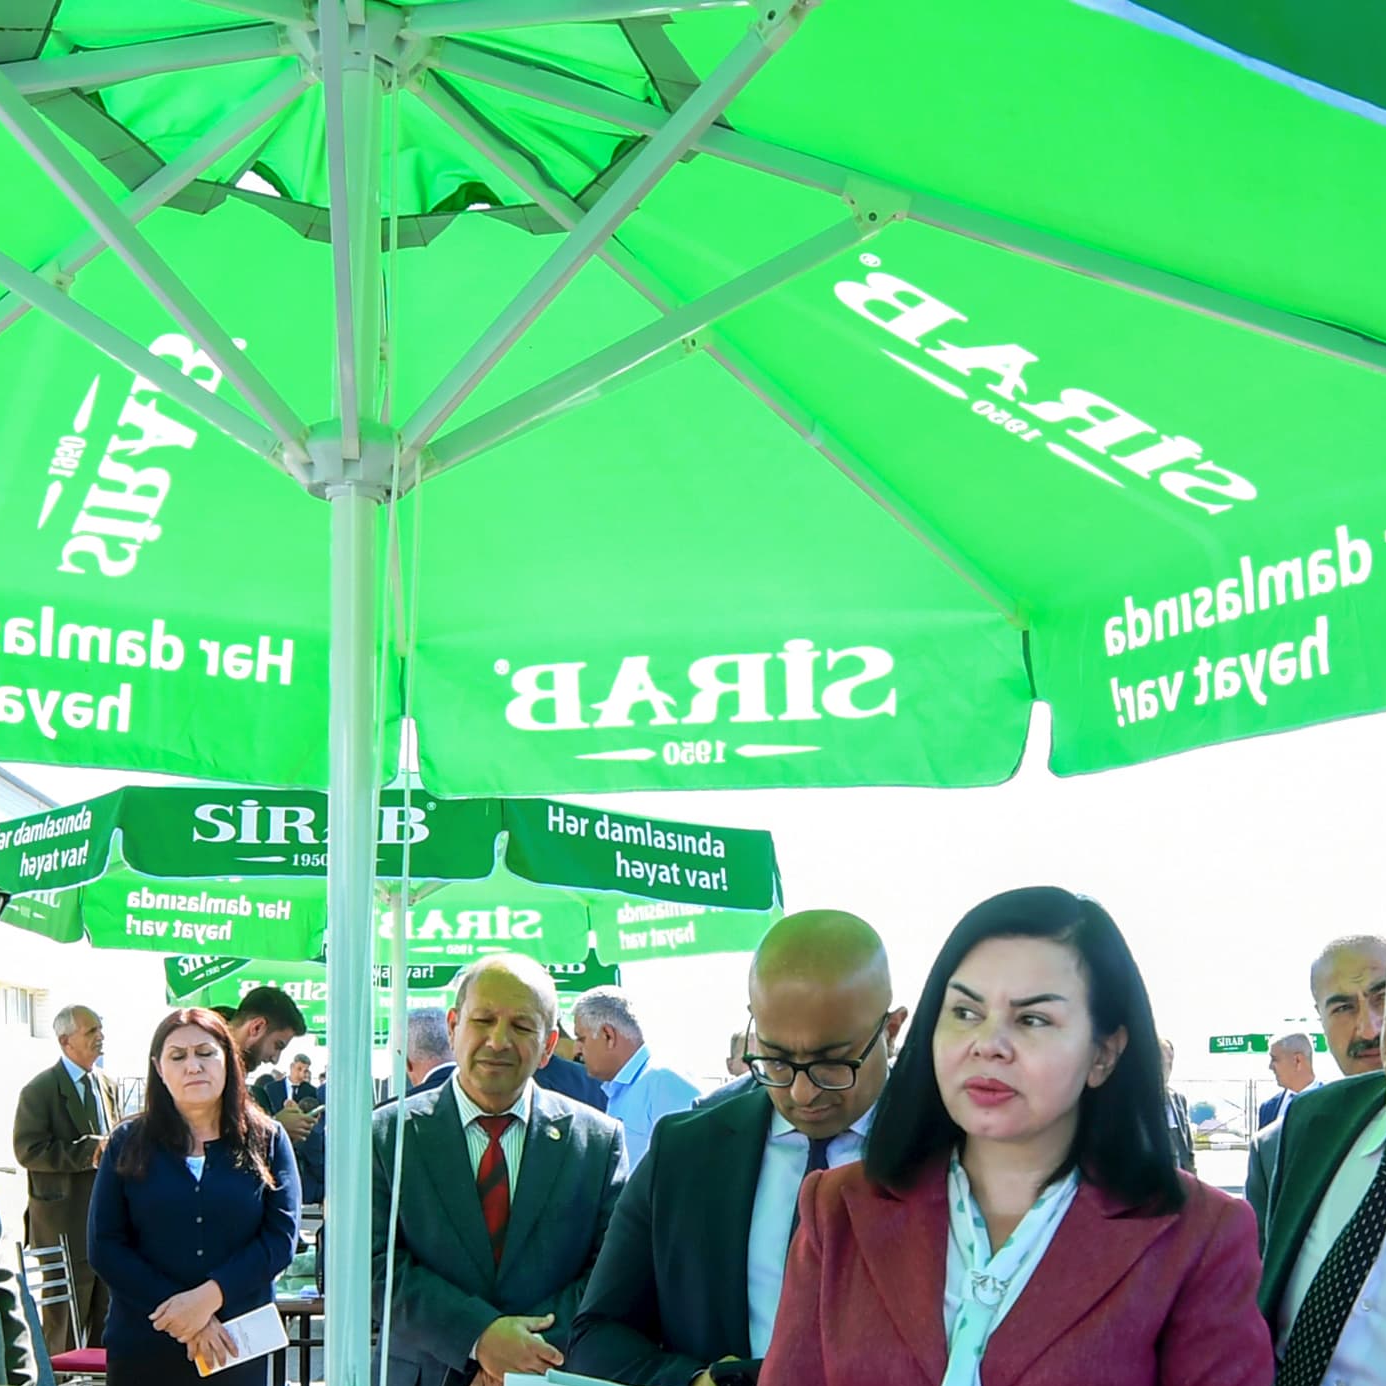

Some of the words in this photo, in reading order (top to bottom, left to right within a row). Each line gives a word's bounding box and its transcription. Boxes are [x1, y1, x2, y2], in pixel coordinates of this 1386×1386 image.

[13, 805, 91, 847] damlasında
[193, 800, 430, 844] SİRB
[548, 805, 589, 837] Hər
[595, 814, 725, 858] damlasında
[20, 846, 60, 880] həyat
[60, 841, 89, 869] var!
[616, 853, 680, 887] həyat
[685, 867, 728, 891] var!
